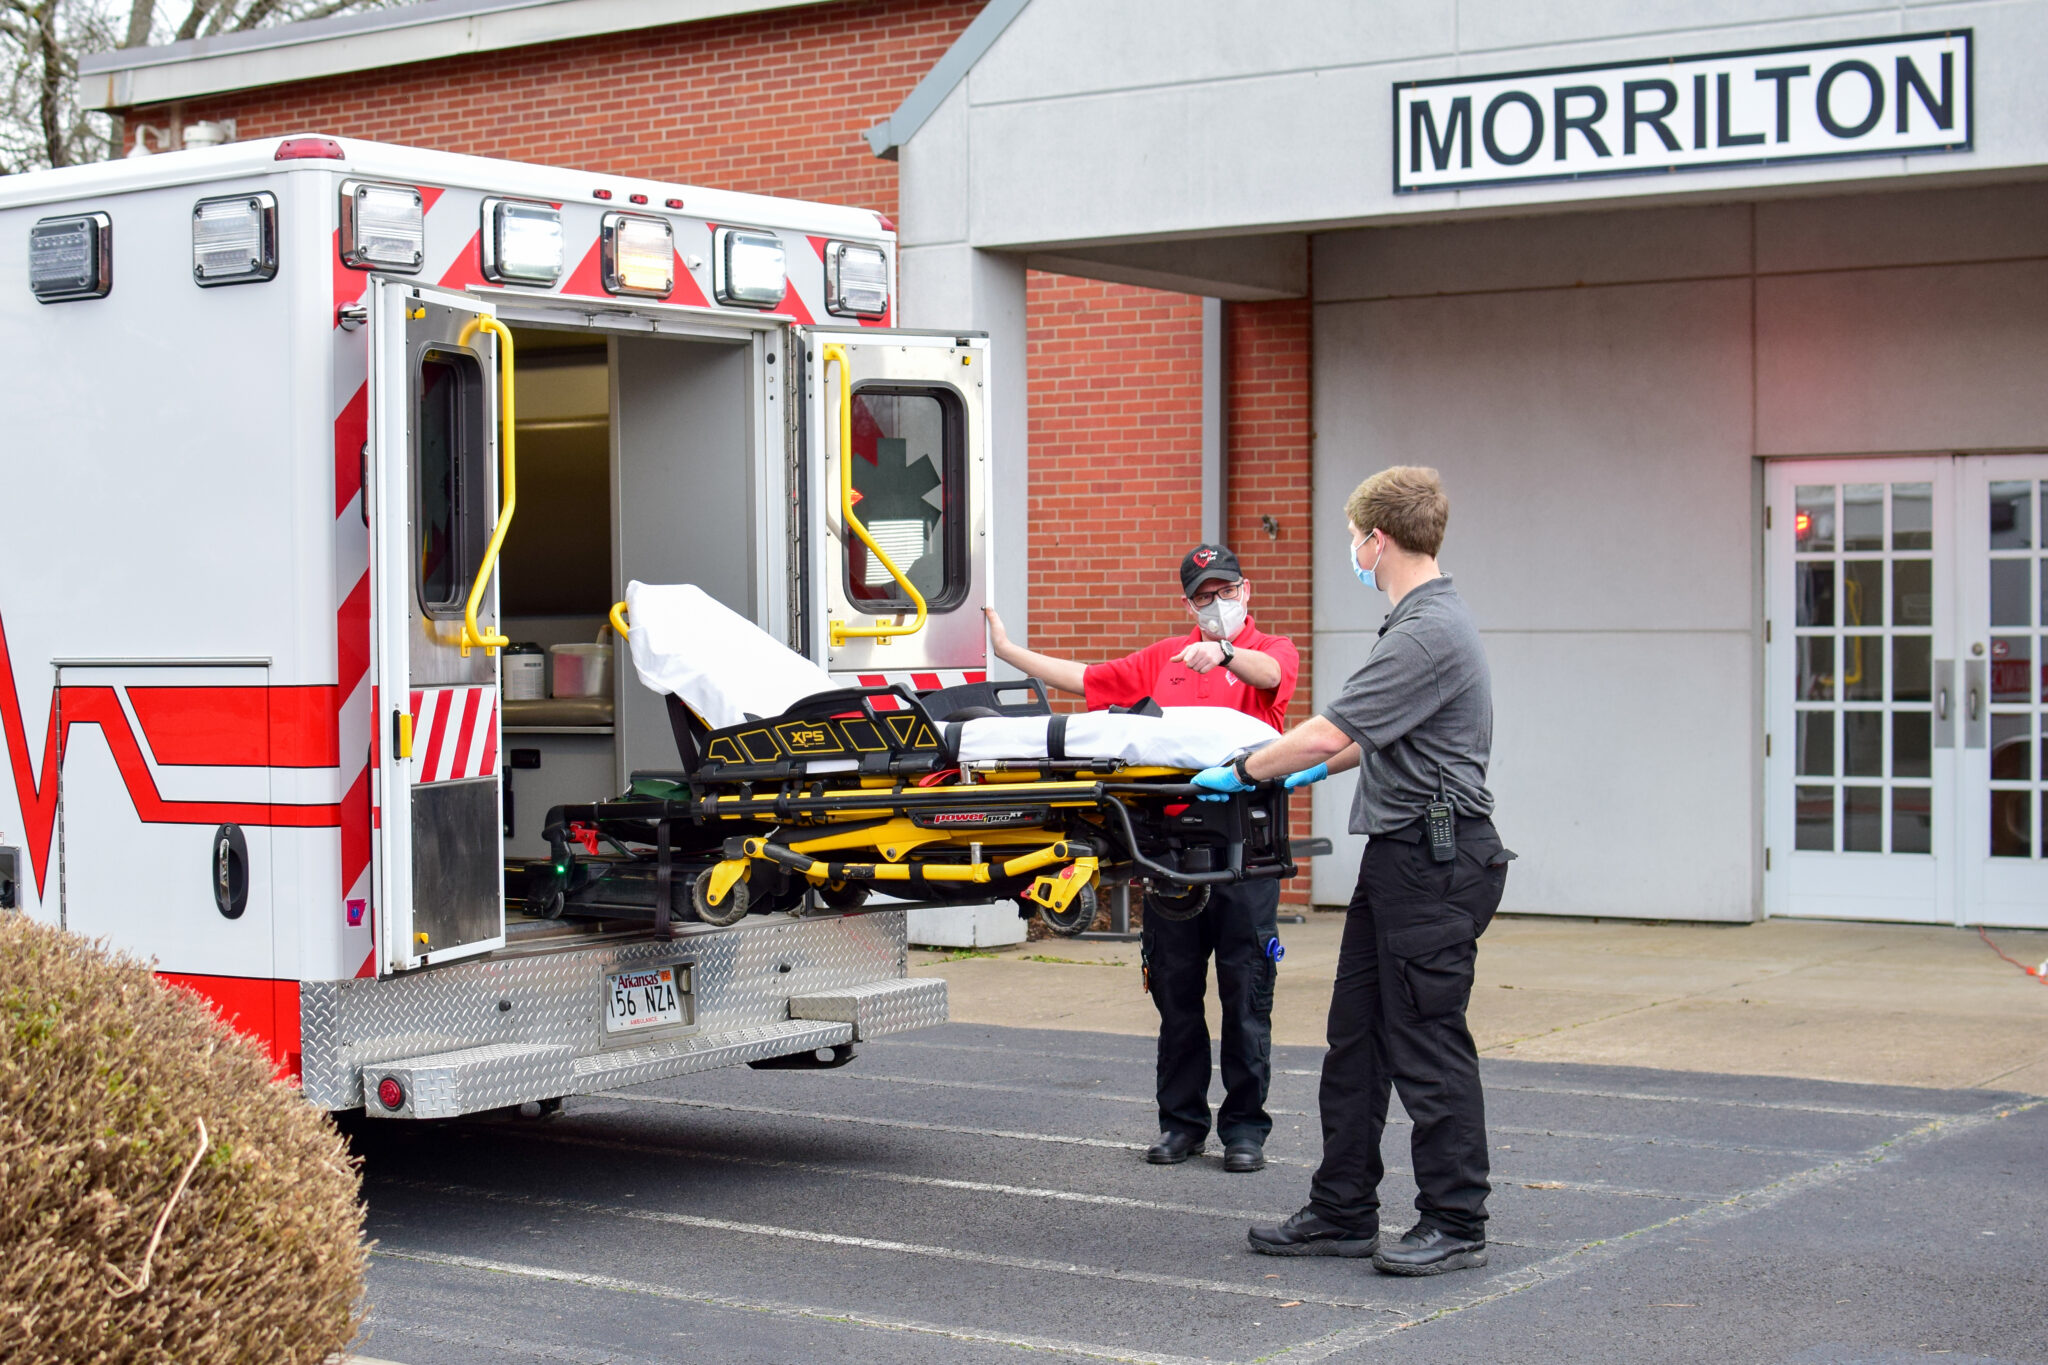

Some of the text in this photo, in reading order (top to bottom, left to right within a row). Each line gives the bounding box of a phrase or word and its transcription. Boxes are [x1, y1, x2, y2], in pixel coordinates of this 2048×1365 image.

[1409, 51, 1954, 173] MORRILTON
[791, 730, 825, 744] XPS
[618, 974, 659, 989] Arkansas
[644, 984, 676, 1013] NZA
